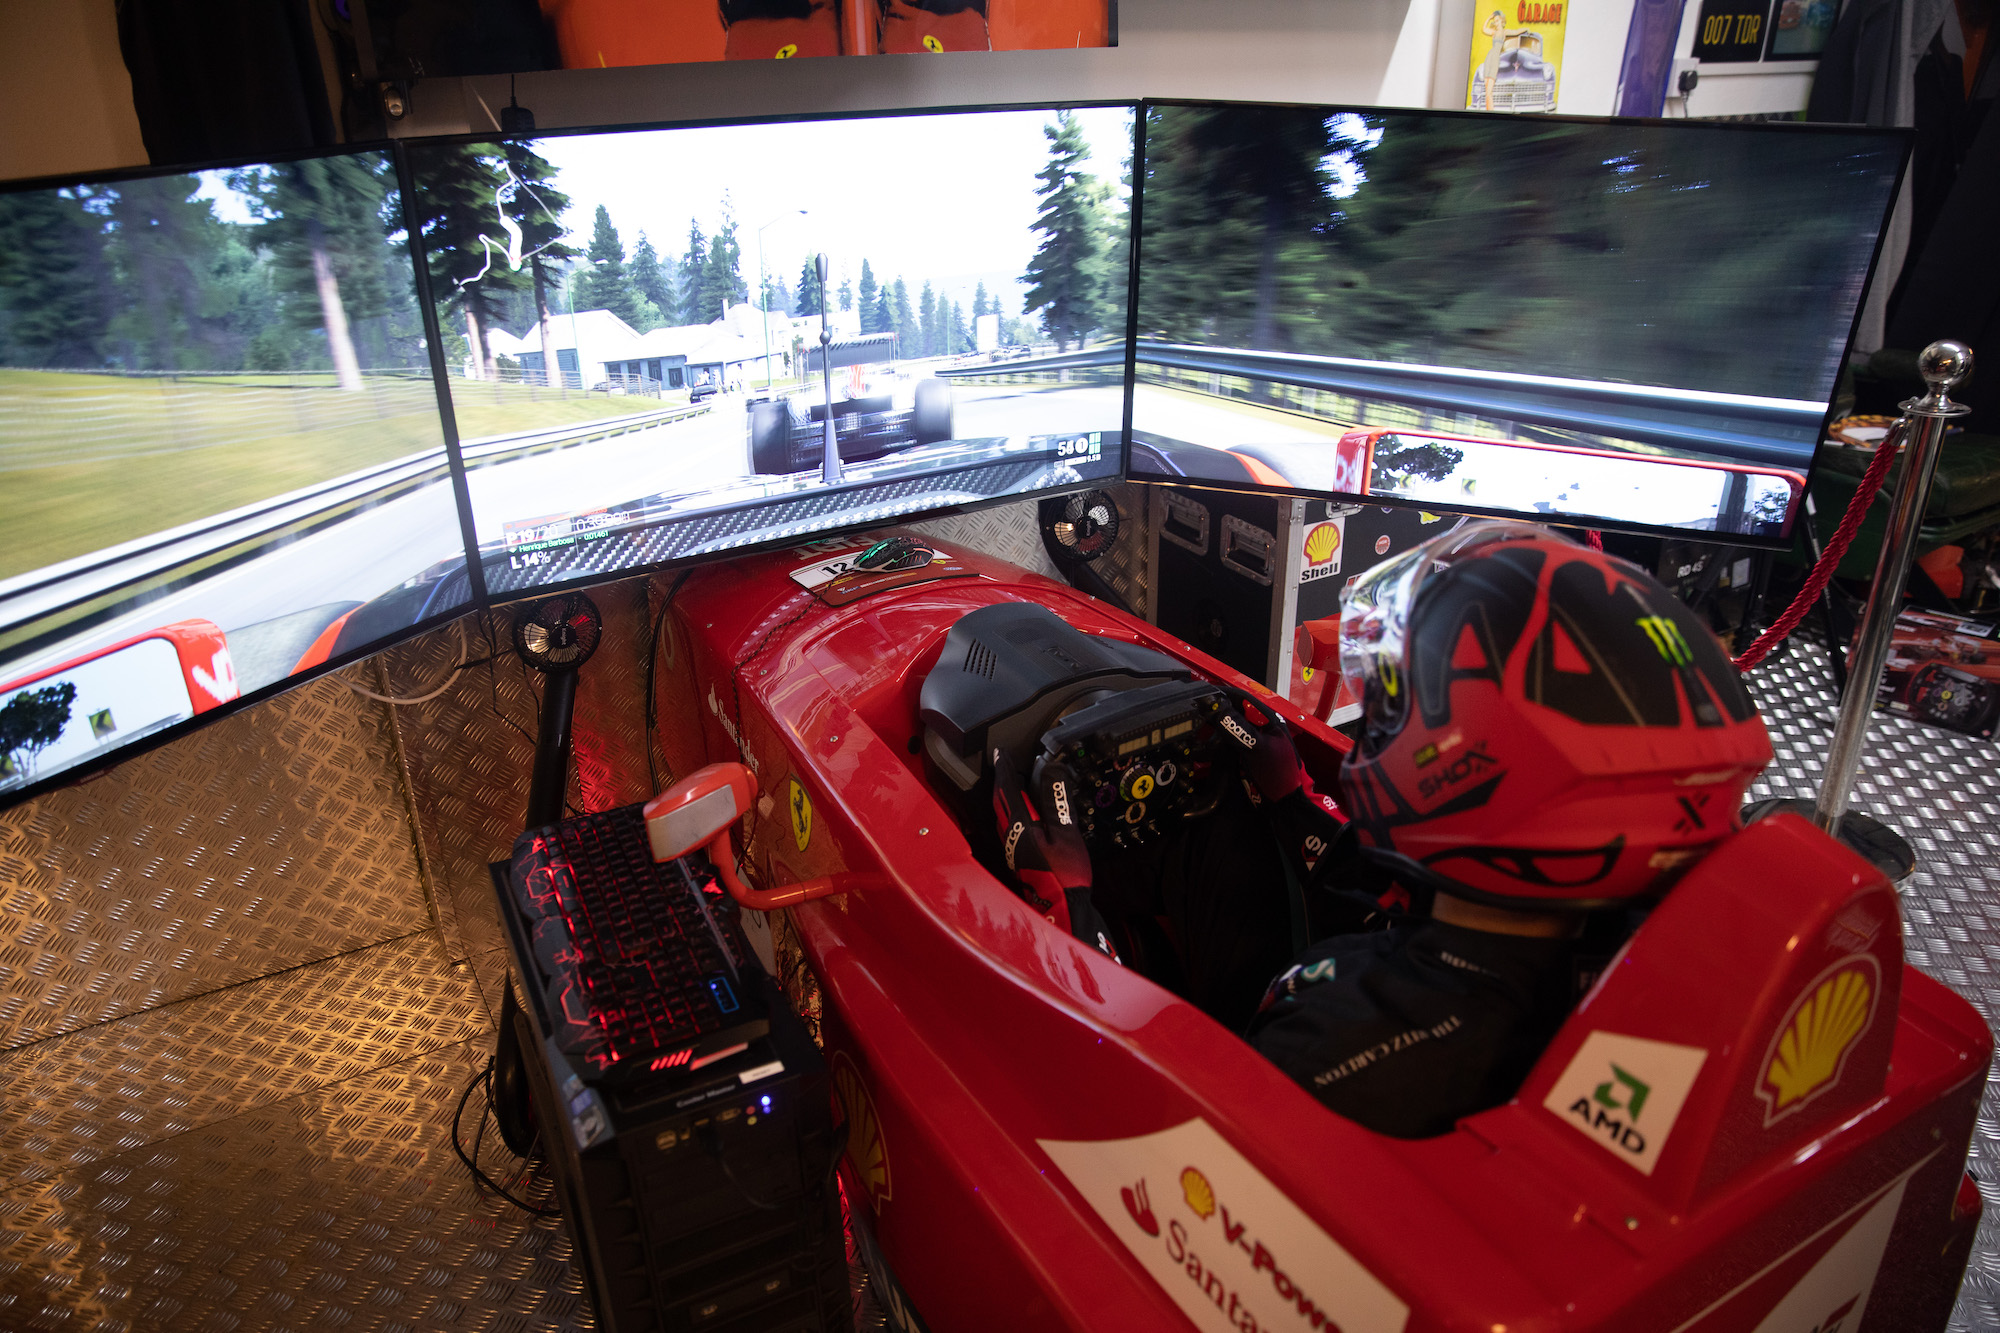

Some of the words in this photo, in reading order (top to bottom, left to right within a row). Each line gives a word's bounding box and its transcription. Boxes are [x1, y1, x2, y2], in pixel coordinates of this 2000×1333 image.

[1517, 0, 1562, 24] GARAGE
[1703, 14, 1733, 45] 007
[1734, 14, 1761, 45] TDR
[519, 541, 548, 553] Henrique
[548, 536, 575, 547] Barbosa
[1301, 562, 1338, 581] Shell
[1221, 715, 1257, 748] sparco
[1053, 781, 1072, 825] sparco
[1570, 1098, 1645, 1153] AMD
[1166, 1220, 1268, 1333] Santa
